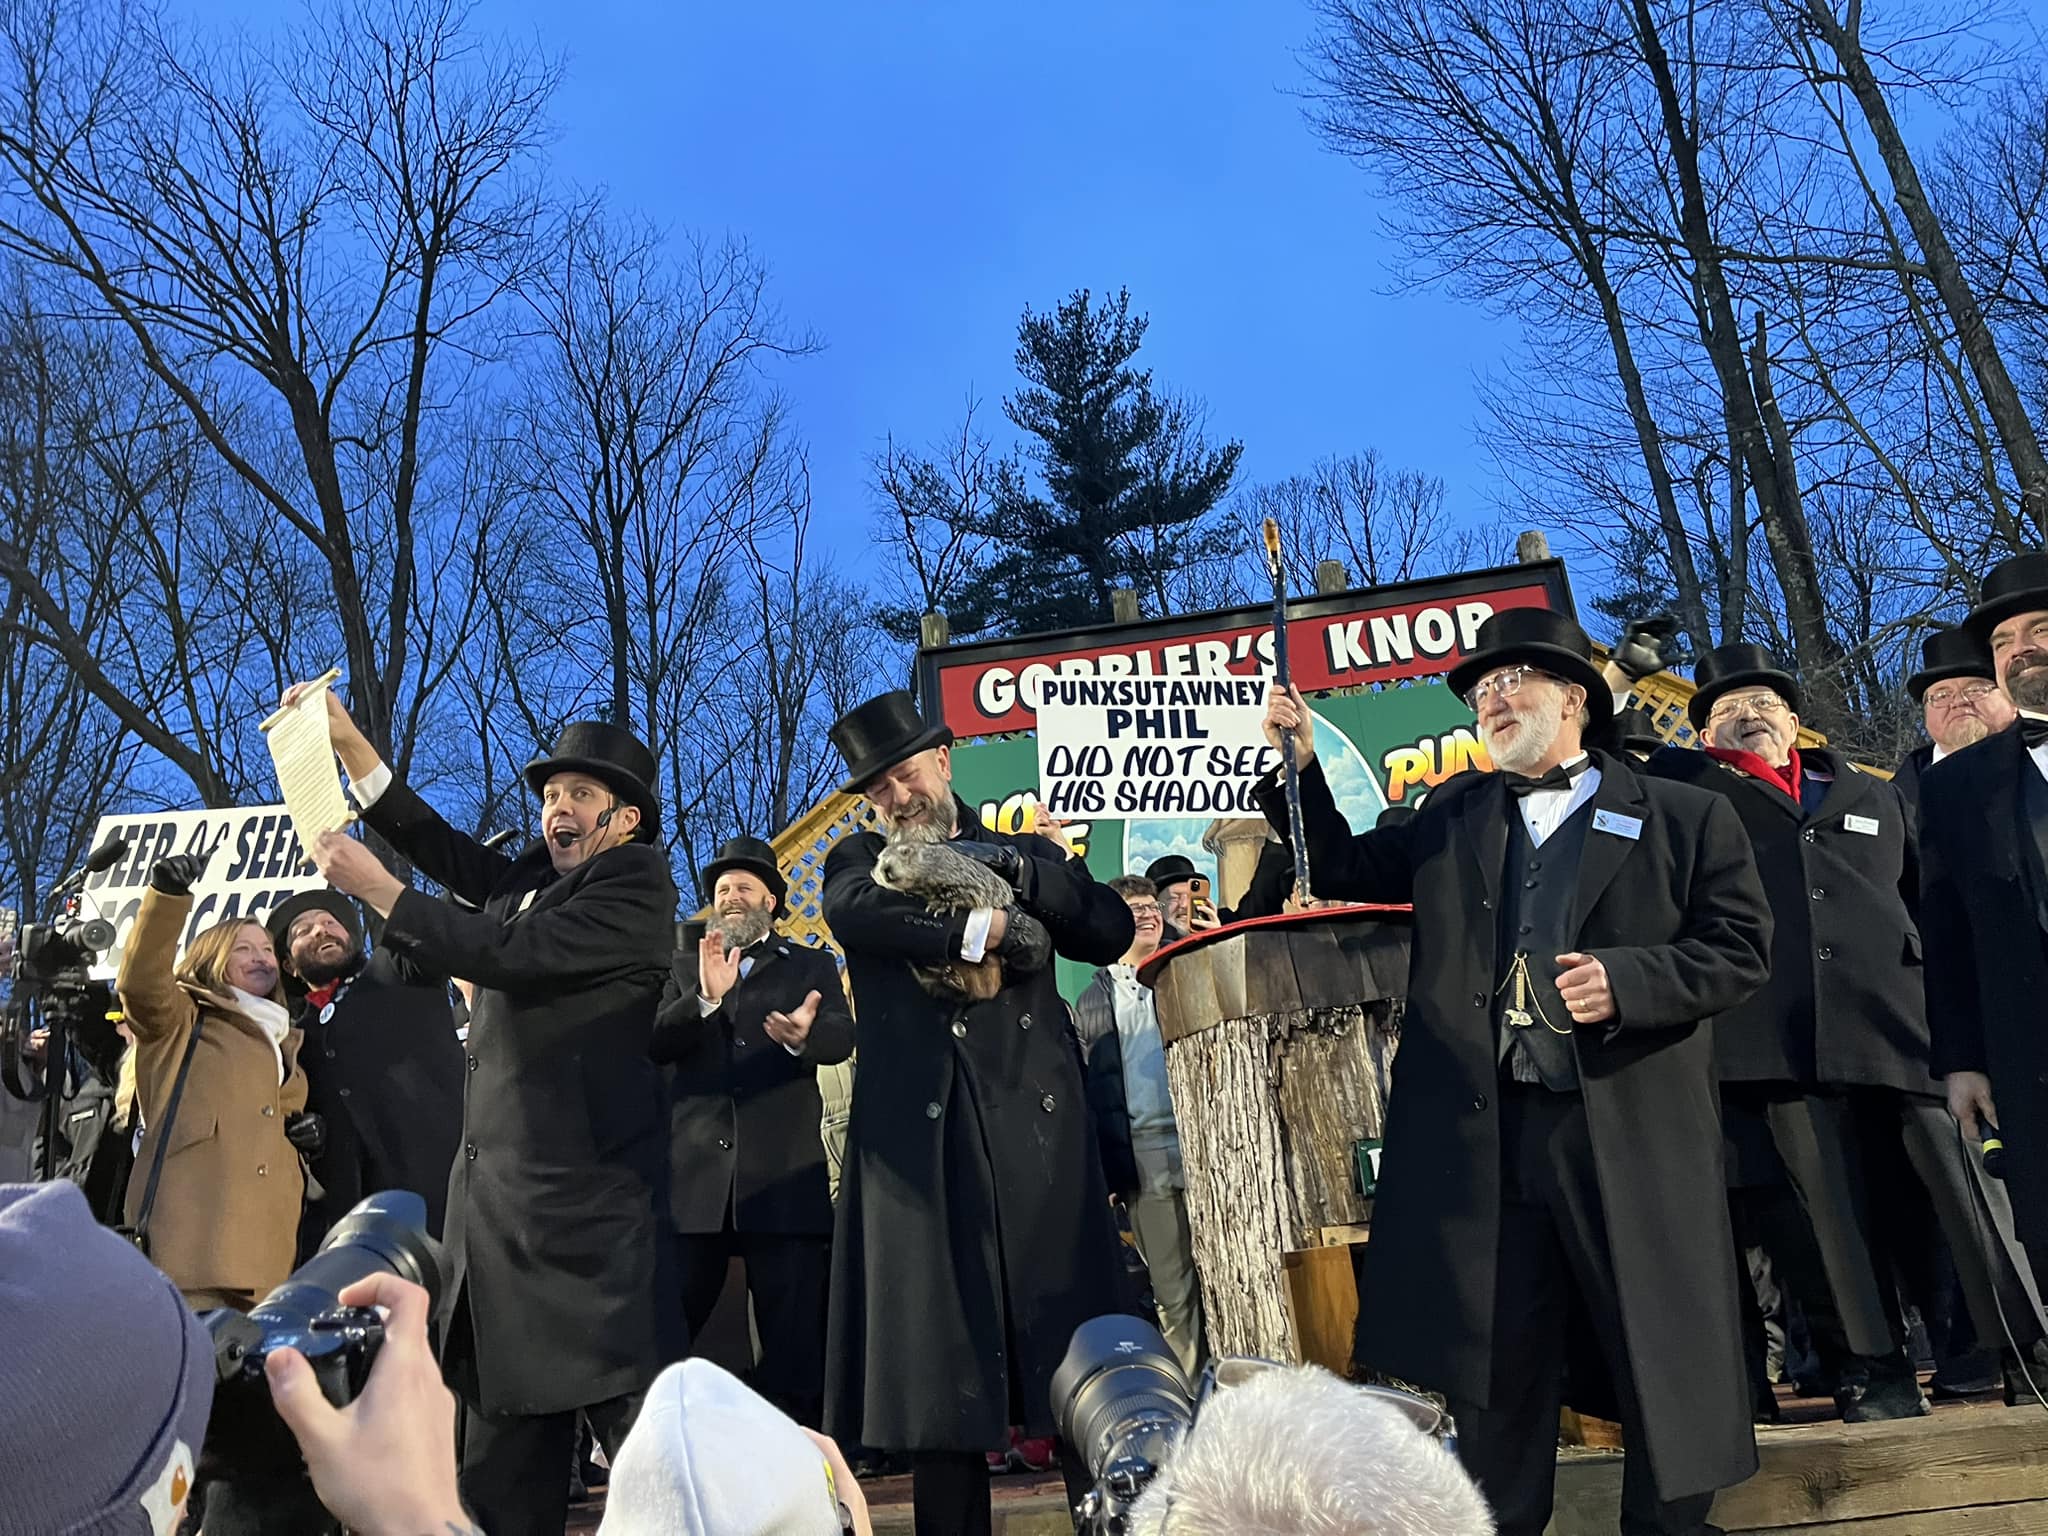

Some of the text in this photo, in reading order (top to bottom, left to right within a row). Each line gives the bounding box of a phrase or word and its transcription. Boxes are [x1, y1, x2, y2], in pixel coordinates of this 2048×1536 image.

[1043, 680, 1265, 706] PUNXSUTAWNEY
[1107, 708, 1209, 739] PHIL
[1046, 744, 1275, 777] DID NOT SEE
[1048, 780, 1106, 813] HIS
[225, 814, 319, 882] SEER
